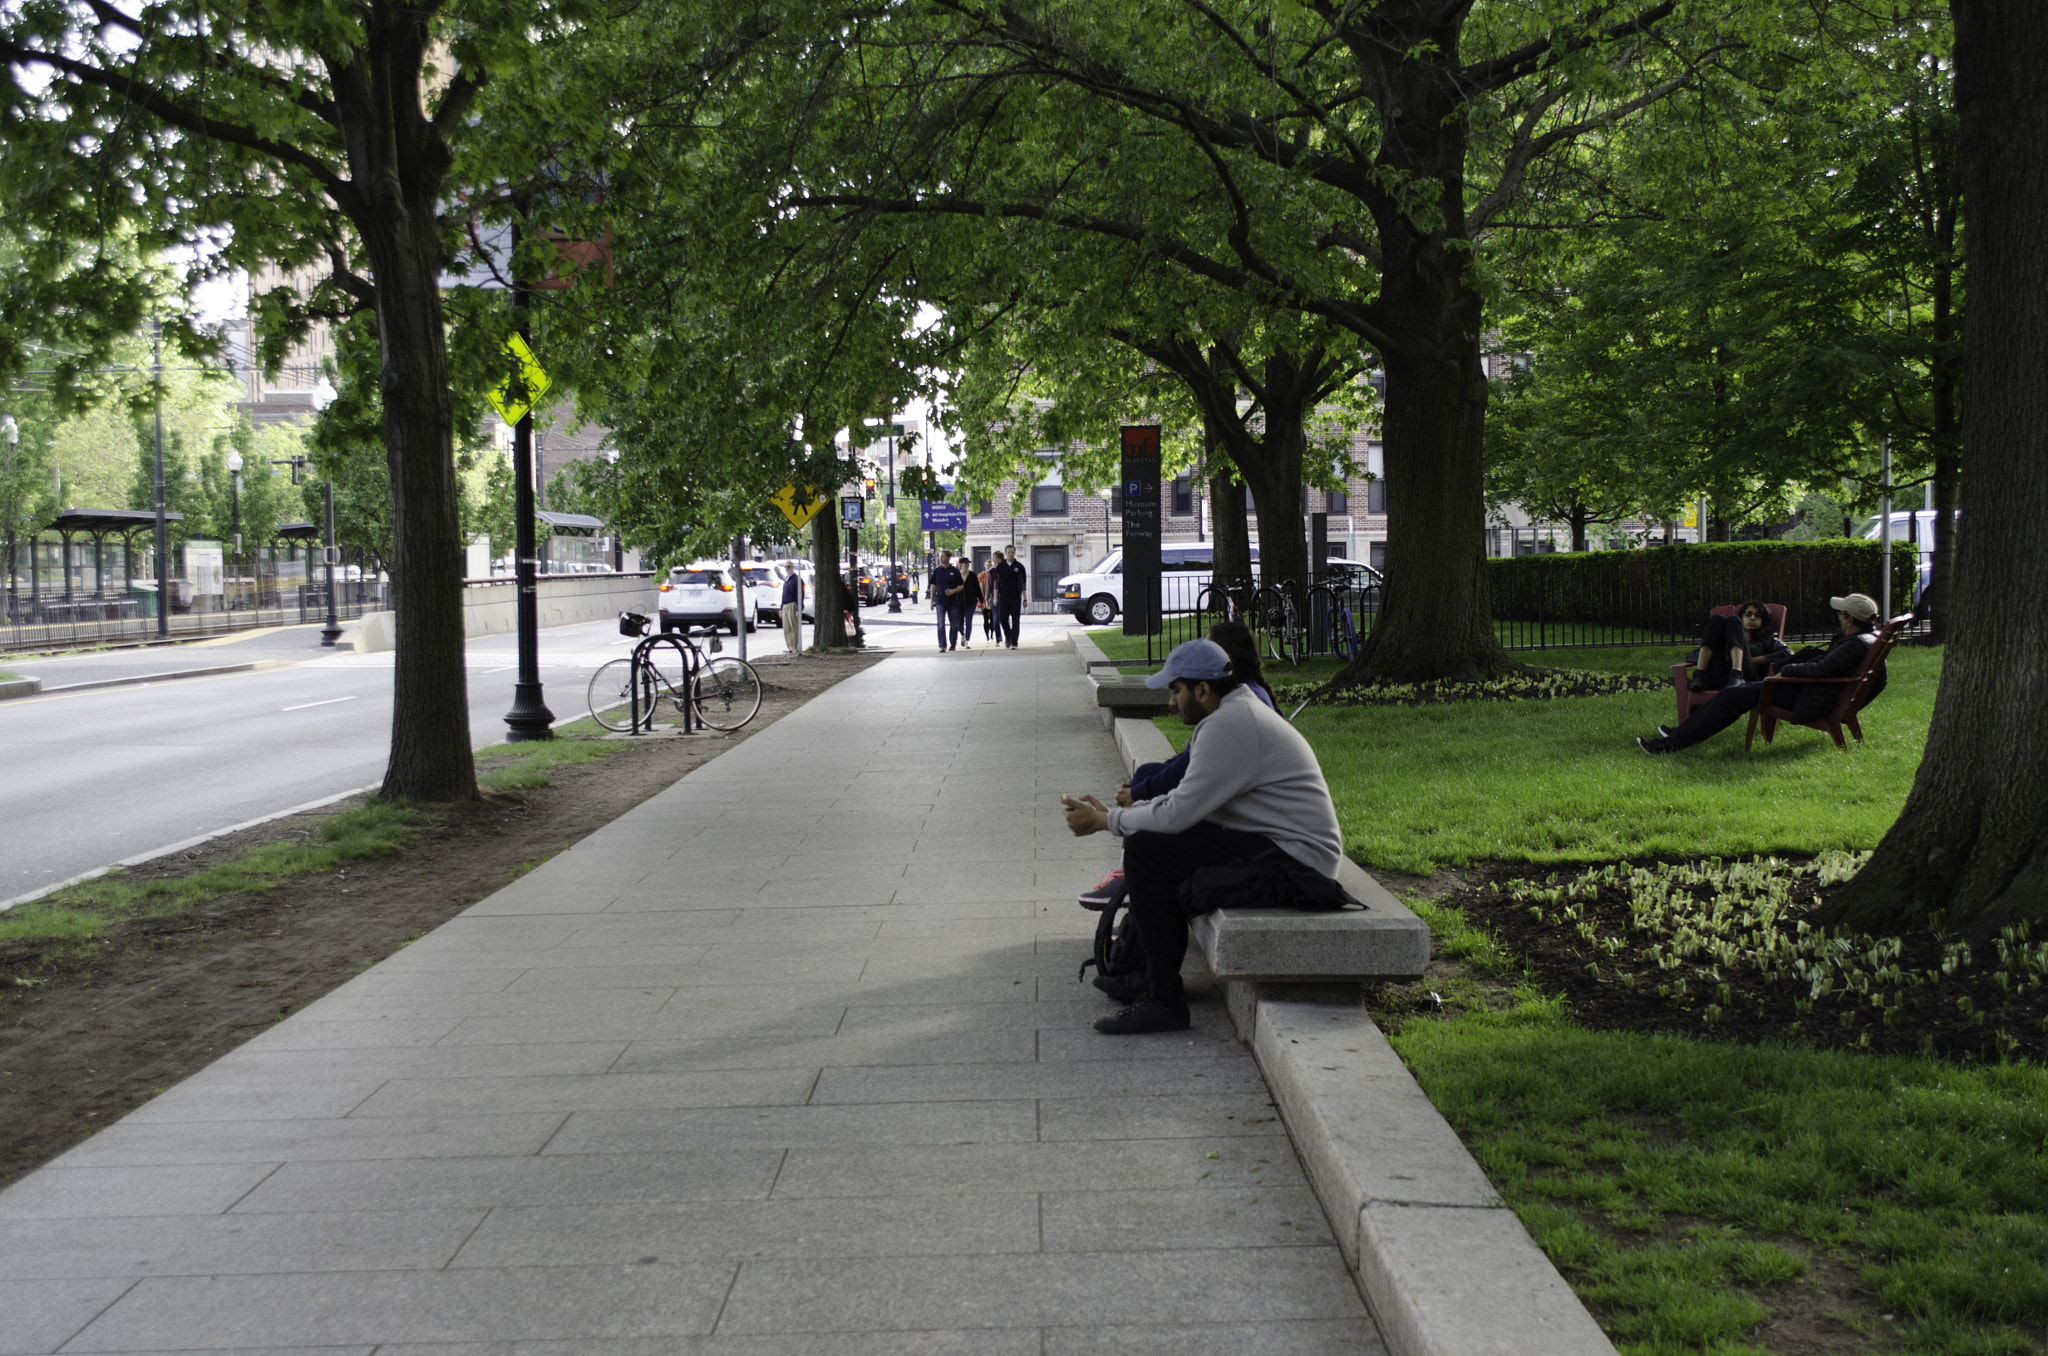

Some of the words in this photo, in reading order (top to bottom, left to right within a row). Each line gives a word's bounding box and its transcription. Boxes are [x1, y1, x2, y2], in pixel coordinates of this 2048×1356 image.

[1124, 456, 1157, 465] BOSTON
[1129, 483, 1138, 494] P
[848, 505, 858, 519] P
[1125, 509, 1153, 518] Parking
[1125, 521, 1141, 529] The
[1125, 529, 1153, 539] Fenway
